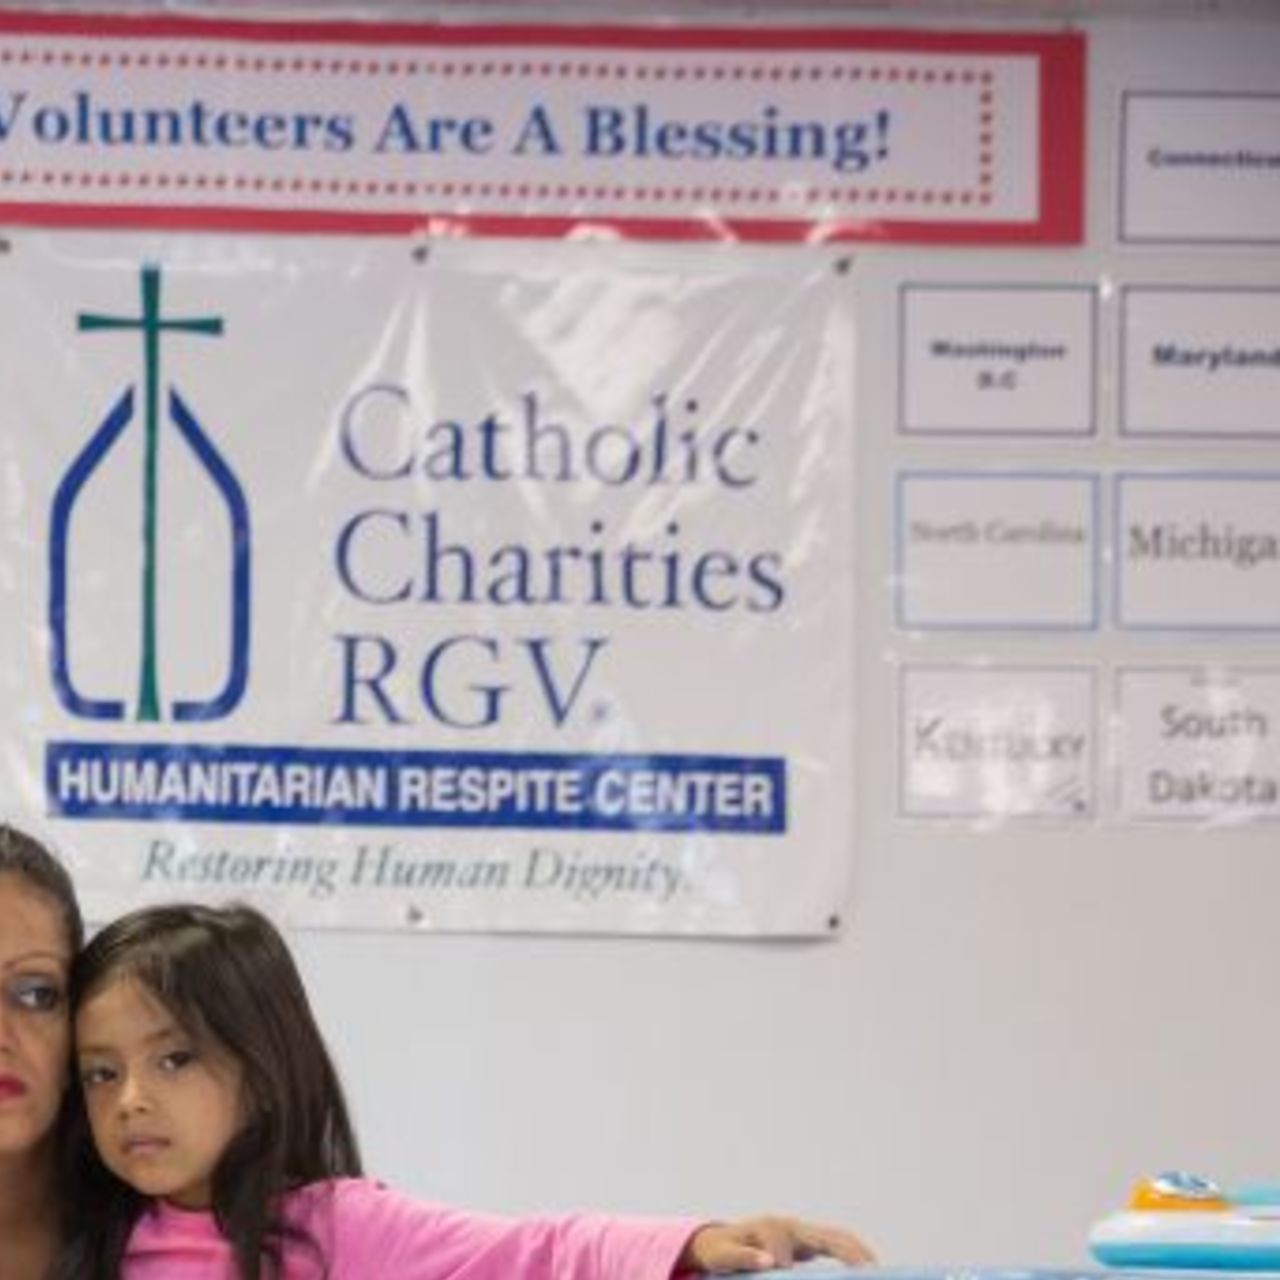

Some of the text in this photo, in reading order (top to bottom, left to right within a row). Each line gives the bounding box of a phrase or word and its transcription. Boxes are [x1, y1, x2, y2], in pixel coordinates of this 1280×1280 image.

[373, 102, 495, 156] Are
[512, 107, 566, 158] A
[582, 106, 893, 172] Blessing!
[336, 383, 762, 489] Catholic
[332, 507, 788, 614] Charities
[1128, 521, 1280, 567] Michiga
[58, 758, 772, 817] HUMANITARIAN RESPITE CENTER
[1149, 768, 1278, 804] Dakota
[139, 838, 336, 892] Restoring
[348, 844, 510, 887] Human
